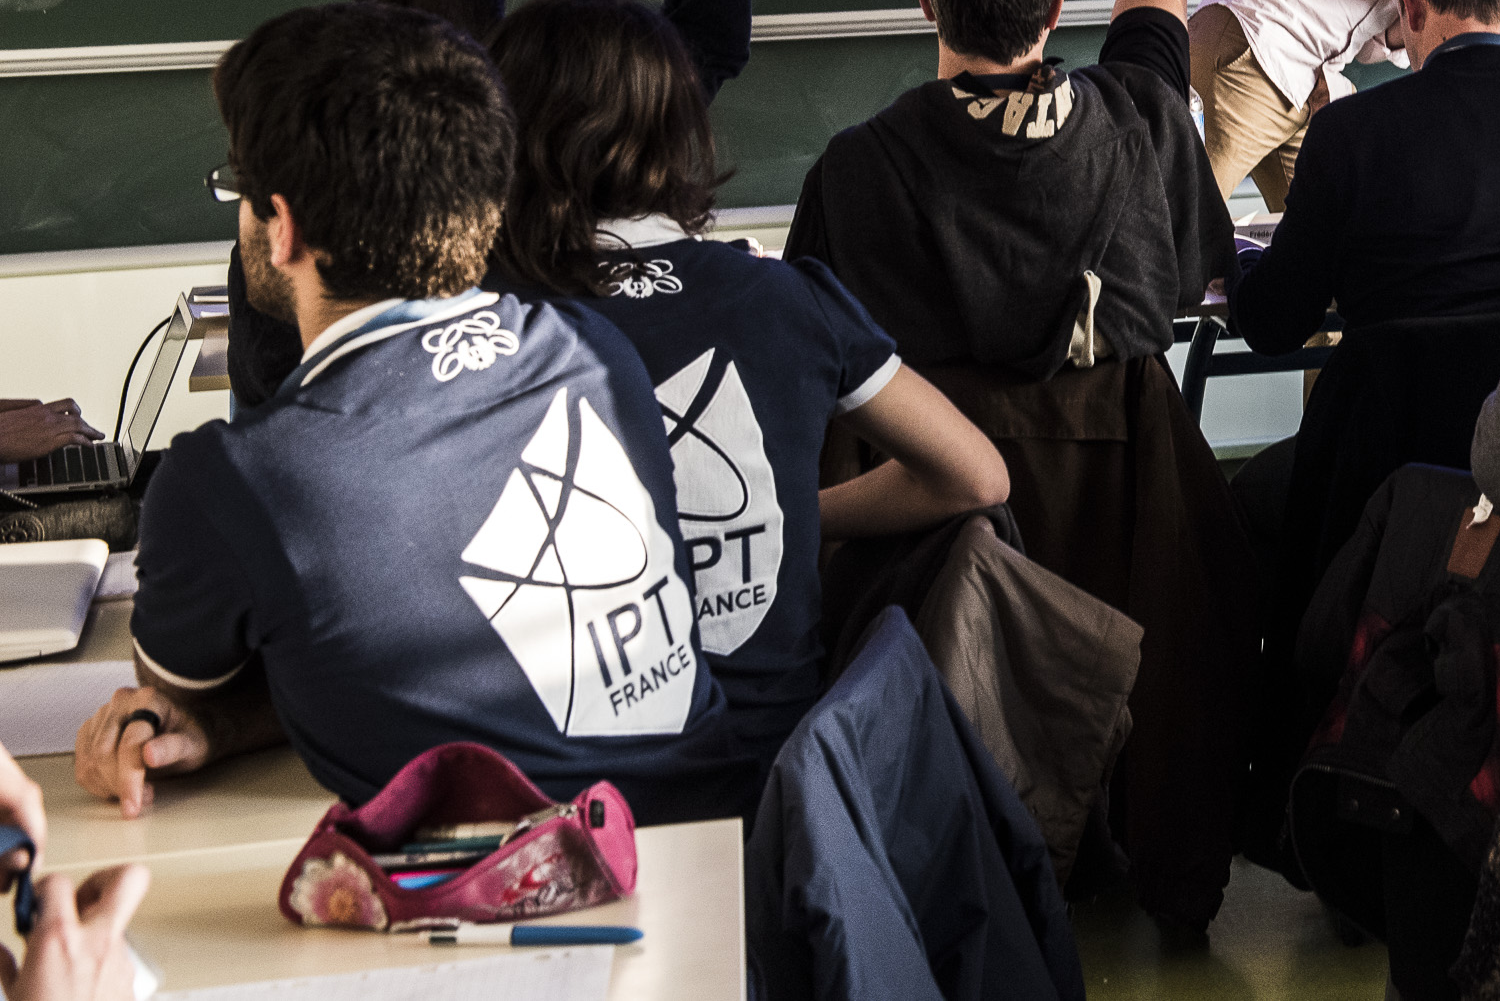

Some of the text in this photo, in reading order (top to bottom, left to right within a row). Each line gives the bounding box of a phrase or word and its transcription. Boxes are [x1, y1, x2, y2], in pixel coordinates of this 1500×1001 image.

[685, 523, 767, 596] PT
[587, 576, 676, 689] IPT
[697, 584, 767, 621] ANCE
[609, 644, 692, 717] FRANCE
